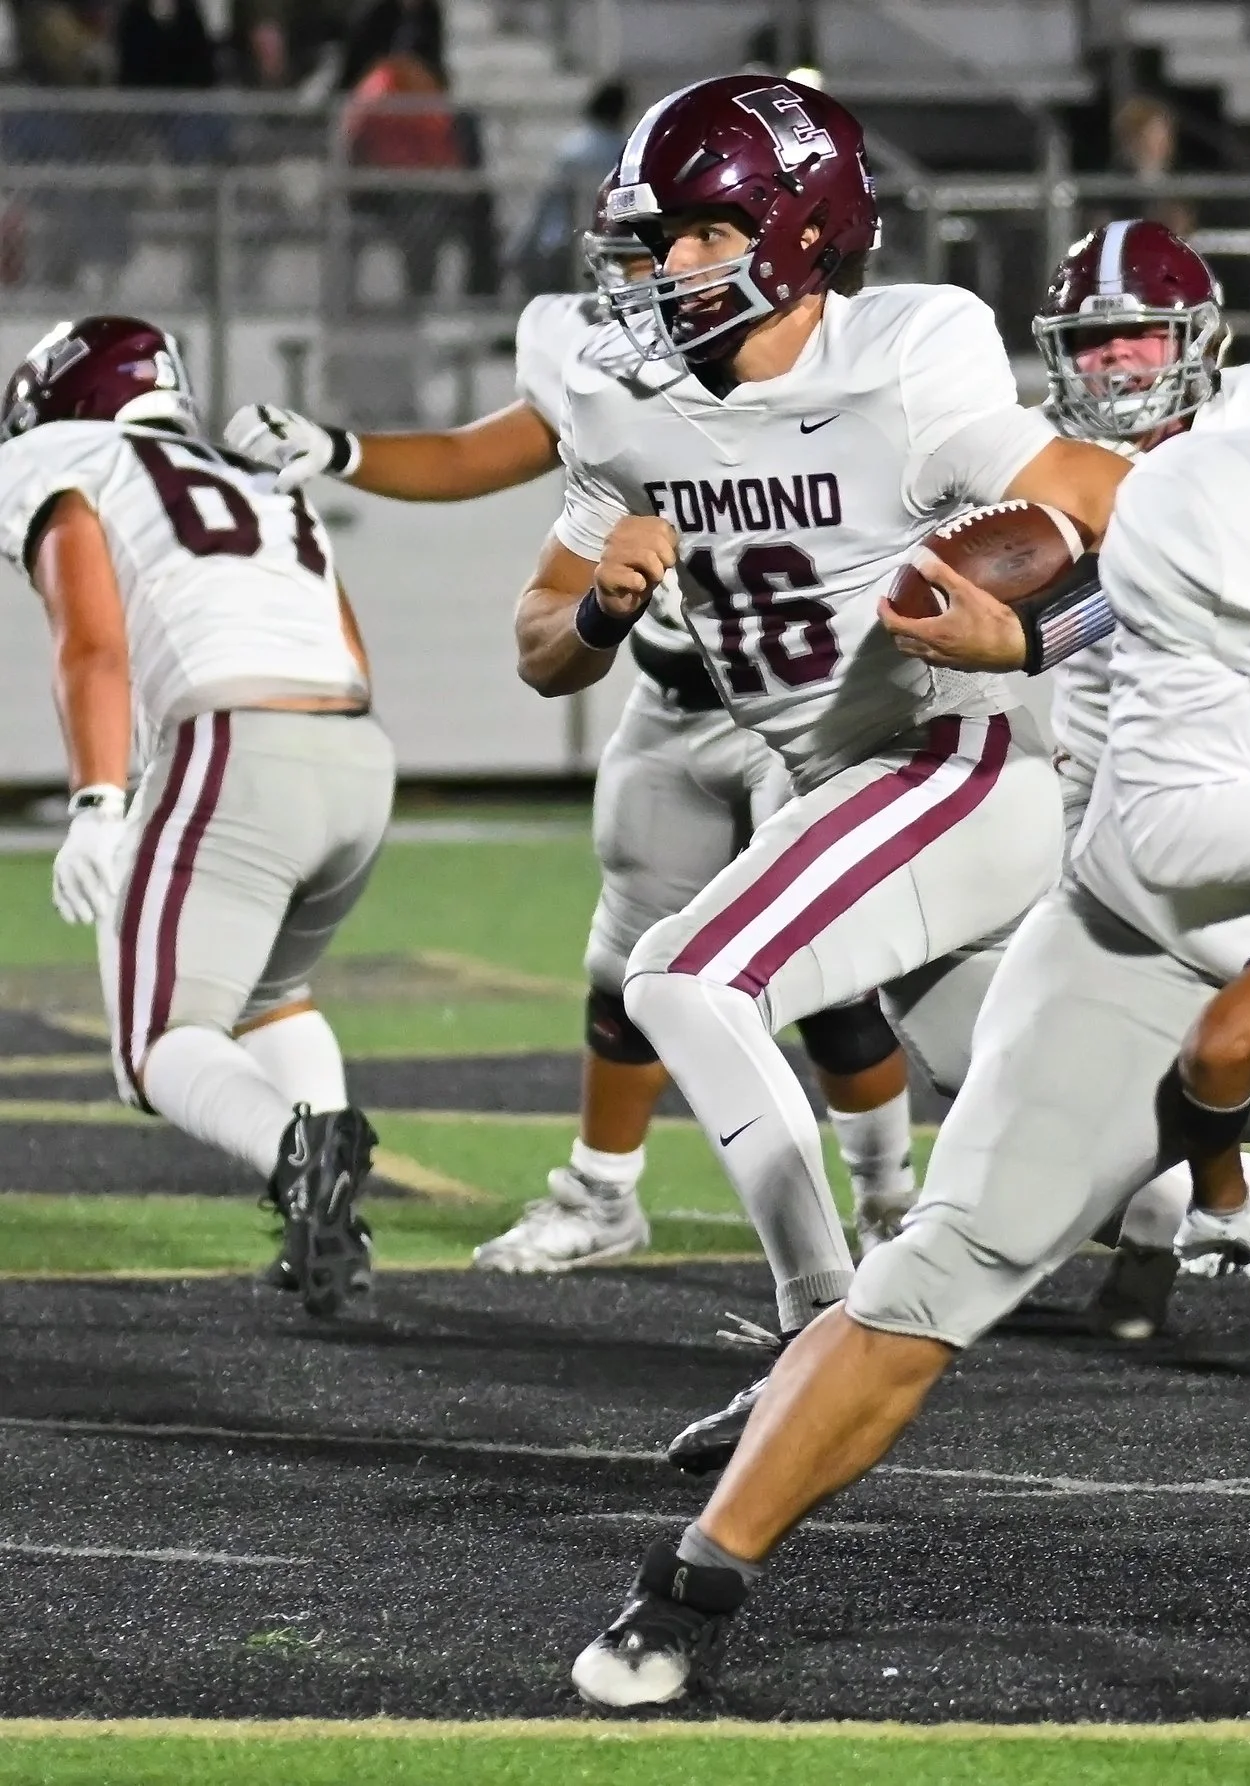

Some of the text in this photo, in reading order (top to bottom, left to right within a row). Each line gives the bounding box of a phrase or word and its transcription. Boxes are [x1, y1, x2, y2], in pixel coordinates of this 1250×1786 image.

[731, 84, 838, 173] E
[644, 473, 842, 533] EDMOND
[684, 541, 843, 698] 16
